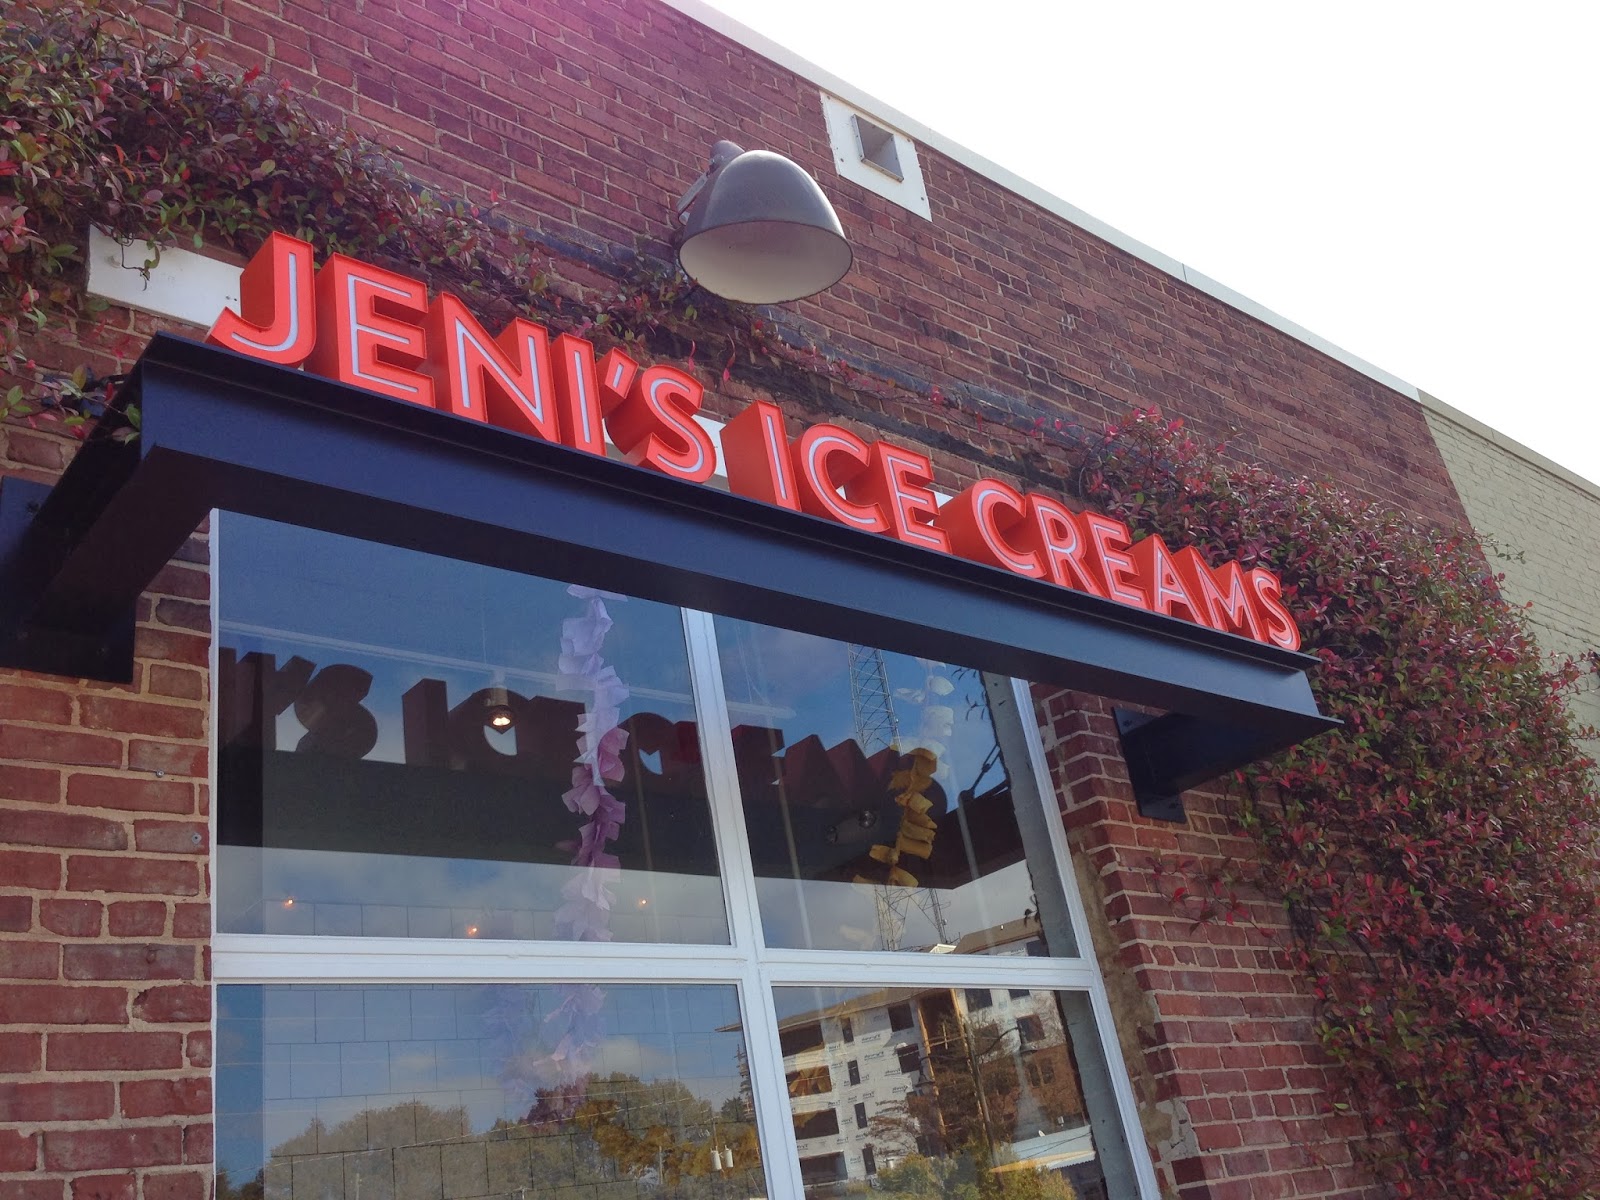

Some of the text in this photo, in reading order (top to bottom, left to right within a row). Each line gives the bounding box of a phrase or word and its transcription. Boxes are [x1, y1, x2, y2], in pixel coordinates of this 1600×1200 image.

[205, 231, 1301, 652] JENI'S ICE CREAMS
